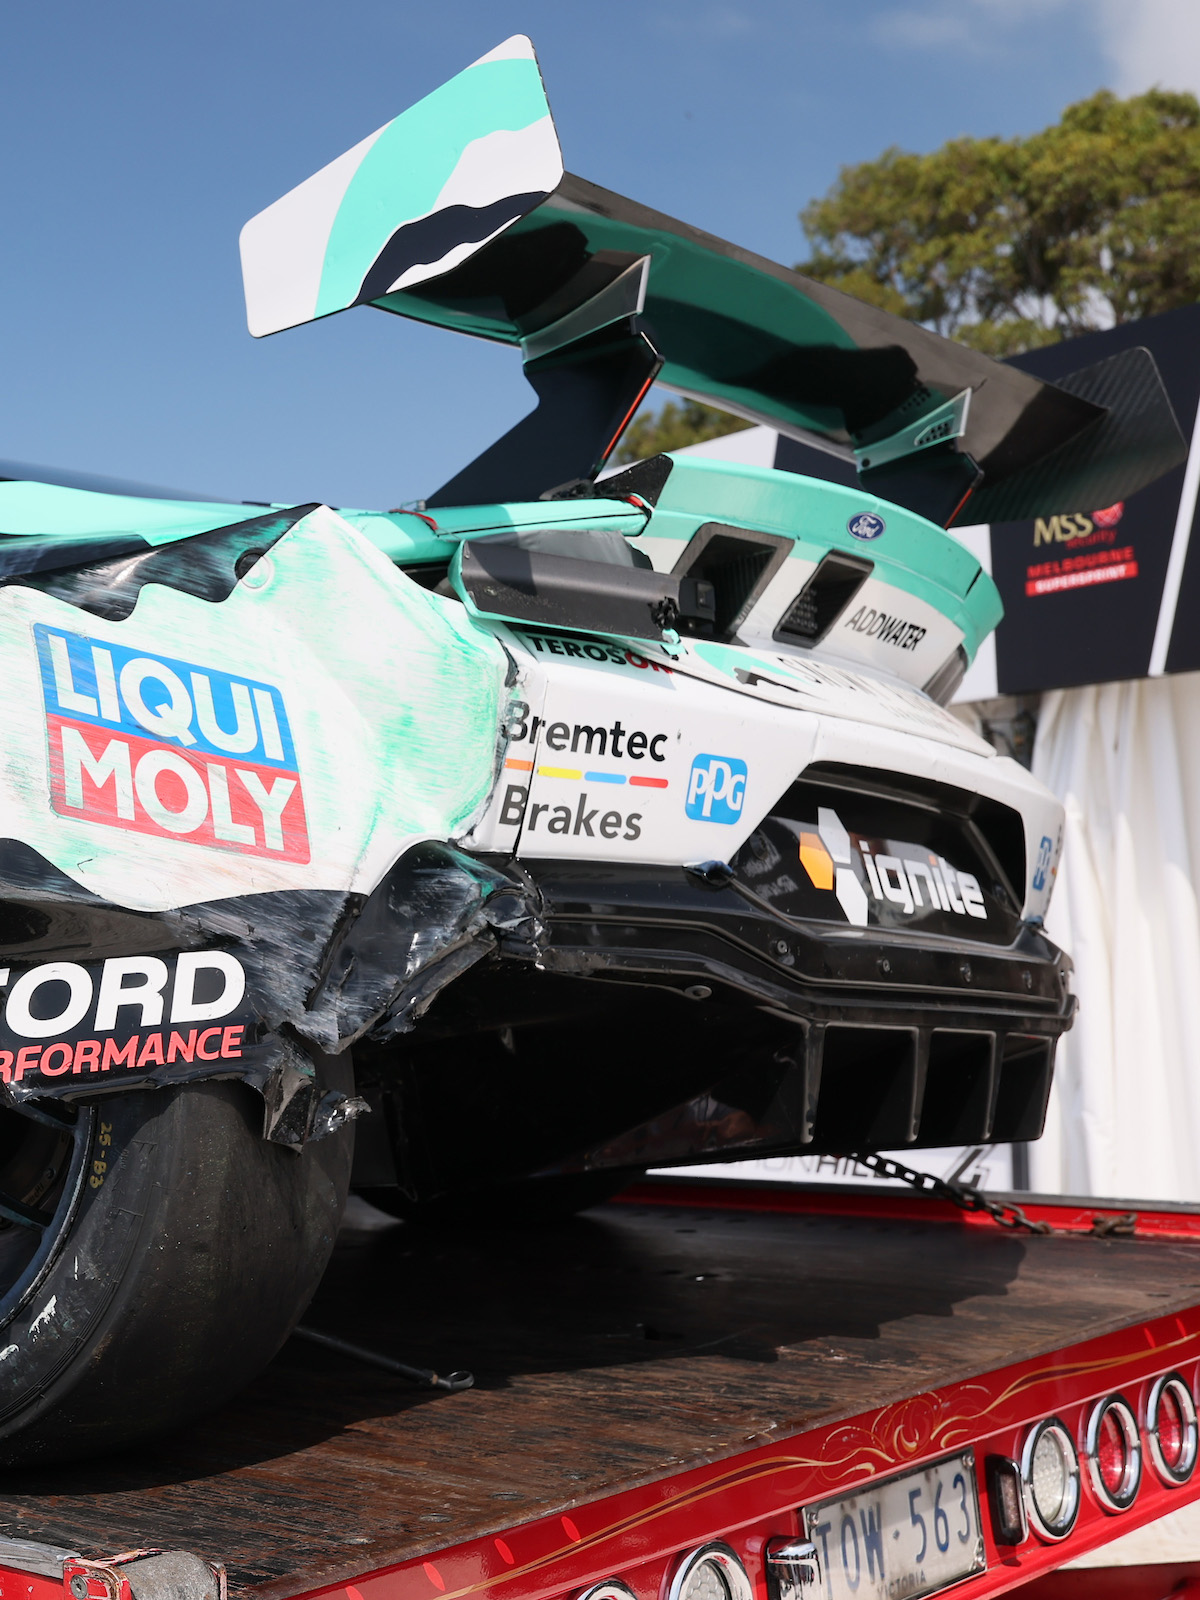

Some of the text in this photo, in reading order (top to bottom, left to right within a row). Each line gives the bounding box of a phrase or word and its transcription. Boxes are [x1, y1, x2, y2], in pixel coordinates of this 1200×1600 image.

[1033, 512, 1094, 547] MSS
[1026, 545, 1135, 579] MELBOURNE
[1034, 564, 1127, 594] SUPERSPRINT
[47, 633, 286, 762] LIQUI
[504, 700, 669, 762] Bremtec
[60, 725, 298, 852] MOLY
[498, 783, 644, 841] Brakes
[687, 759, 747, 817] PPG
[858, 839, 988, 920] ignite
